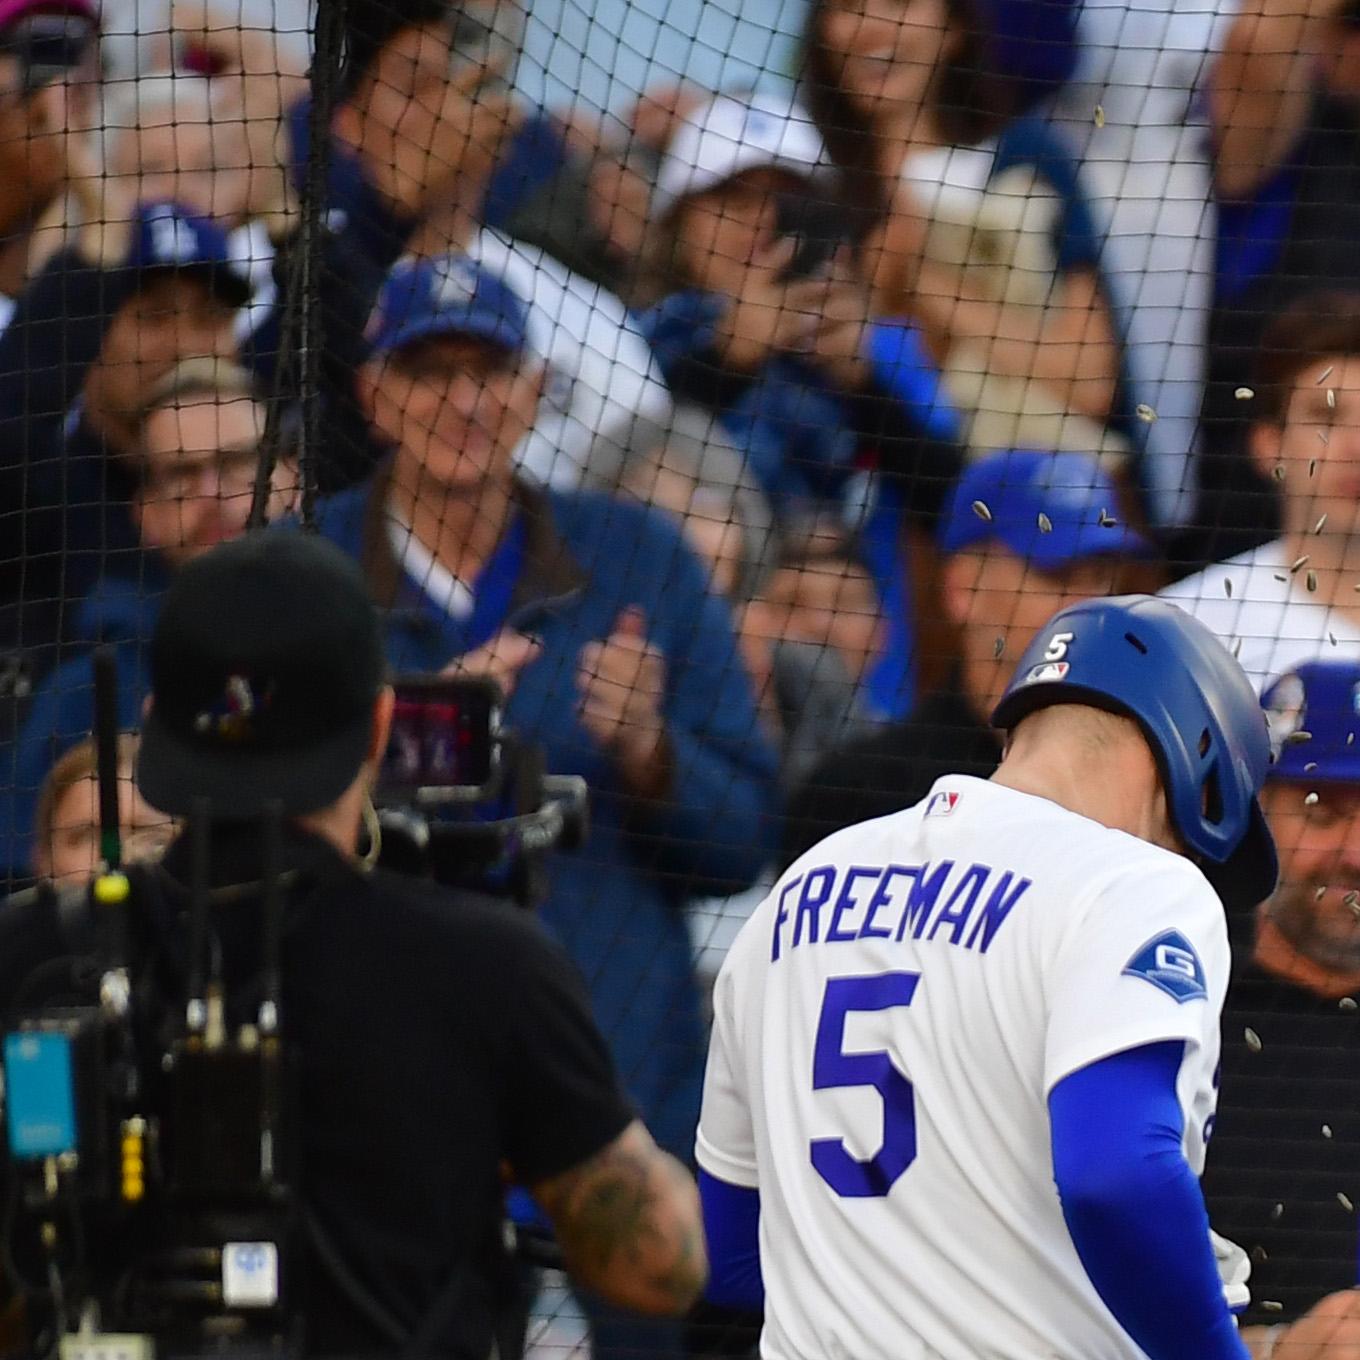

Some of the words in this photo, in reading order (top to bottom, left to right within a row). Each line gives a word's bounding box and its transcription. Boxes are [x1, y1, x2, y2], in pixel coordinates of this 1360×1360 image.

[1044, 631, 1075, 661] 5
[771, 859, 1033, 963] FREEMAN
[809, 968, 922, 1199] 5
